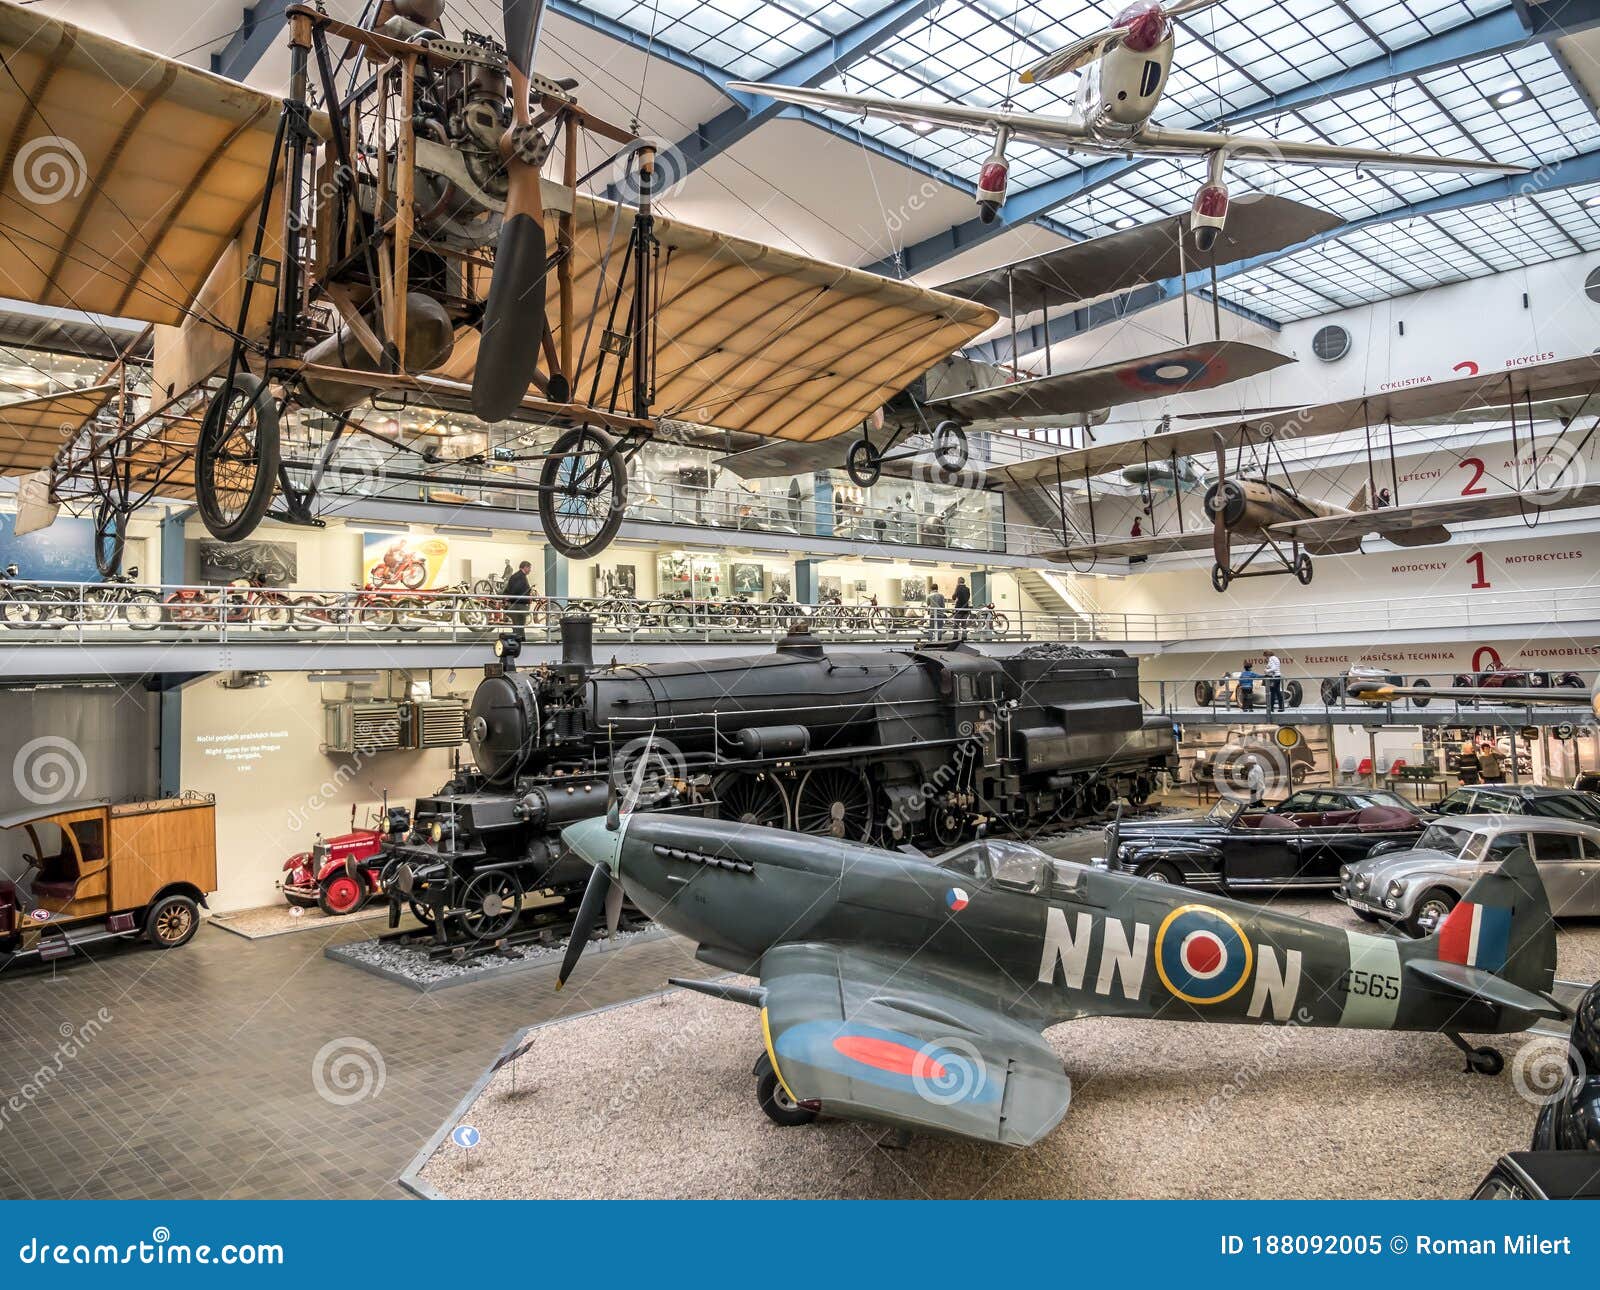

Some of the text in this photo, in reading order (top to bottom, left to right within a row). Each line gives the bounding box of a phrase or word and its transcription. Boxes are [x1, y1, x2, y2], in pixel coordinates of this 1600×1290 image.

[1380, 351, 1555, 391] CYKLISTIKA BICYCLES
[1458, 457, 1488, 497] 2
[1391, 550, 1583, 589] MOTOCYKLY 1 MOTORCYCLES
[1304, 655, 1349, 664] ŽELEZNICE
[1360, 652, 1405, 662] HASIČSKÁ
[1408, 651, 1455, 661] TECHNIKA
[1520, 647, 1599, 658] AUTOMOBILES
[1038, 907, 1302, 1021] NN N
